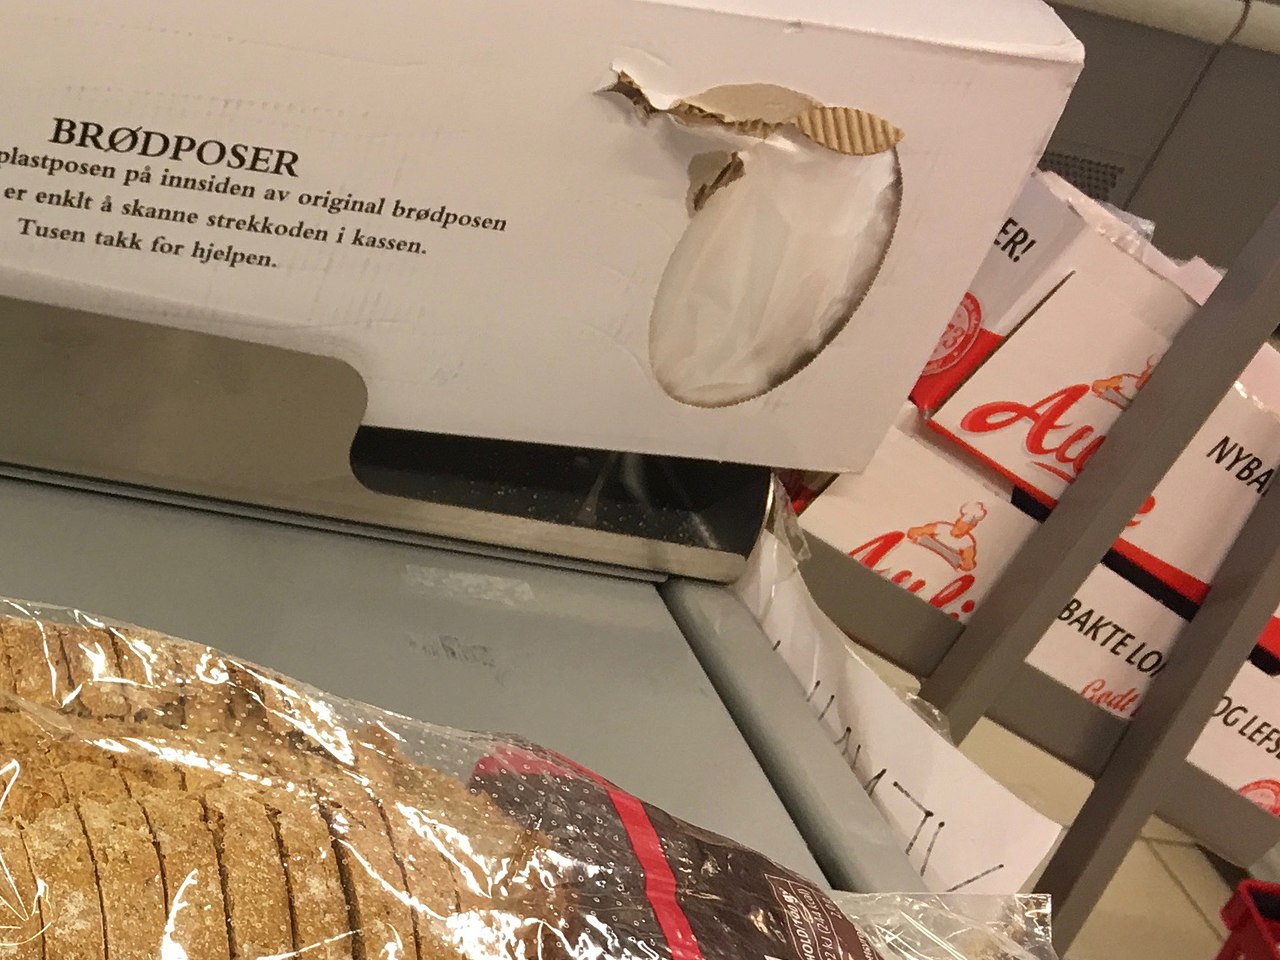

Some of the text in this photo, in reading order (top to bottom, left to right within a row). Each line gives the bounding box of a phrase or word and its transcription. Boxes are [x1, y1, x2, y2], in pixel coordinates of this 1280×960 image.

[48, 117, 299, 177] BRØDPOSER
[4, 186, 28, 201] er
[35, 189, 94, 211] enklt
[100, 195, 113, 213] å
[121, 198, 199, 225] skanne
[206, 212, 328, 242] strekkoden
[336, 227, 346, 243] i
[351, 228, 427, 254] kassen.
[123, 165, 152, 186] på
[160, 168, 256, 198] innsiden
[264, 187, 291, 202] av
[298, 190, 386, 215] original
[391, 199, 508, 232] brødposen
[17, 217, 278, 268] Tusen takk for hjelpen.
[1206, 435, 1276, 497] NYBA
[1057, 598, 1168, 679] BAKTE LO
[1237, 715, 1280, 760] LEFS
